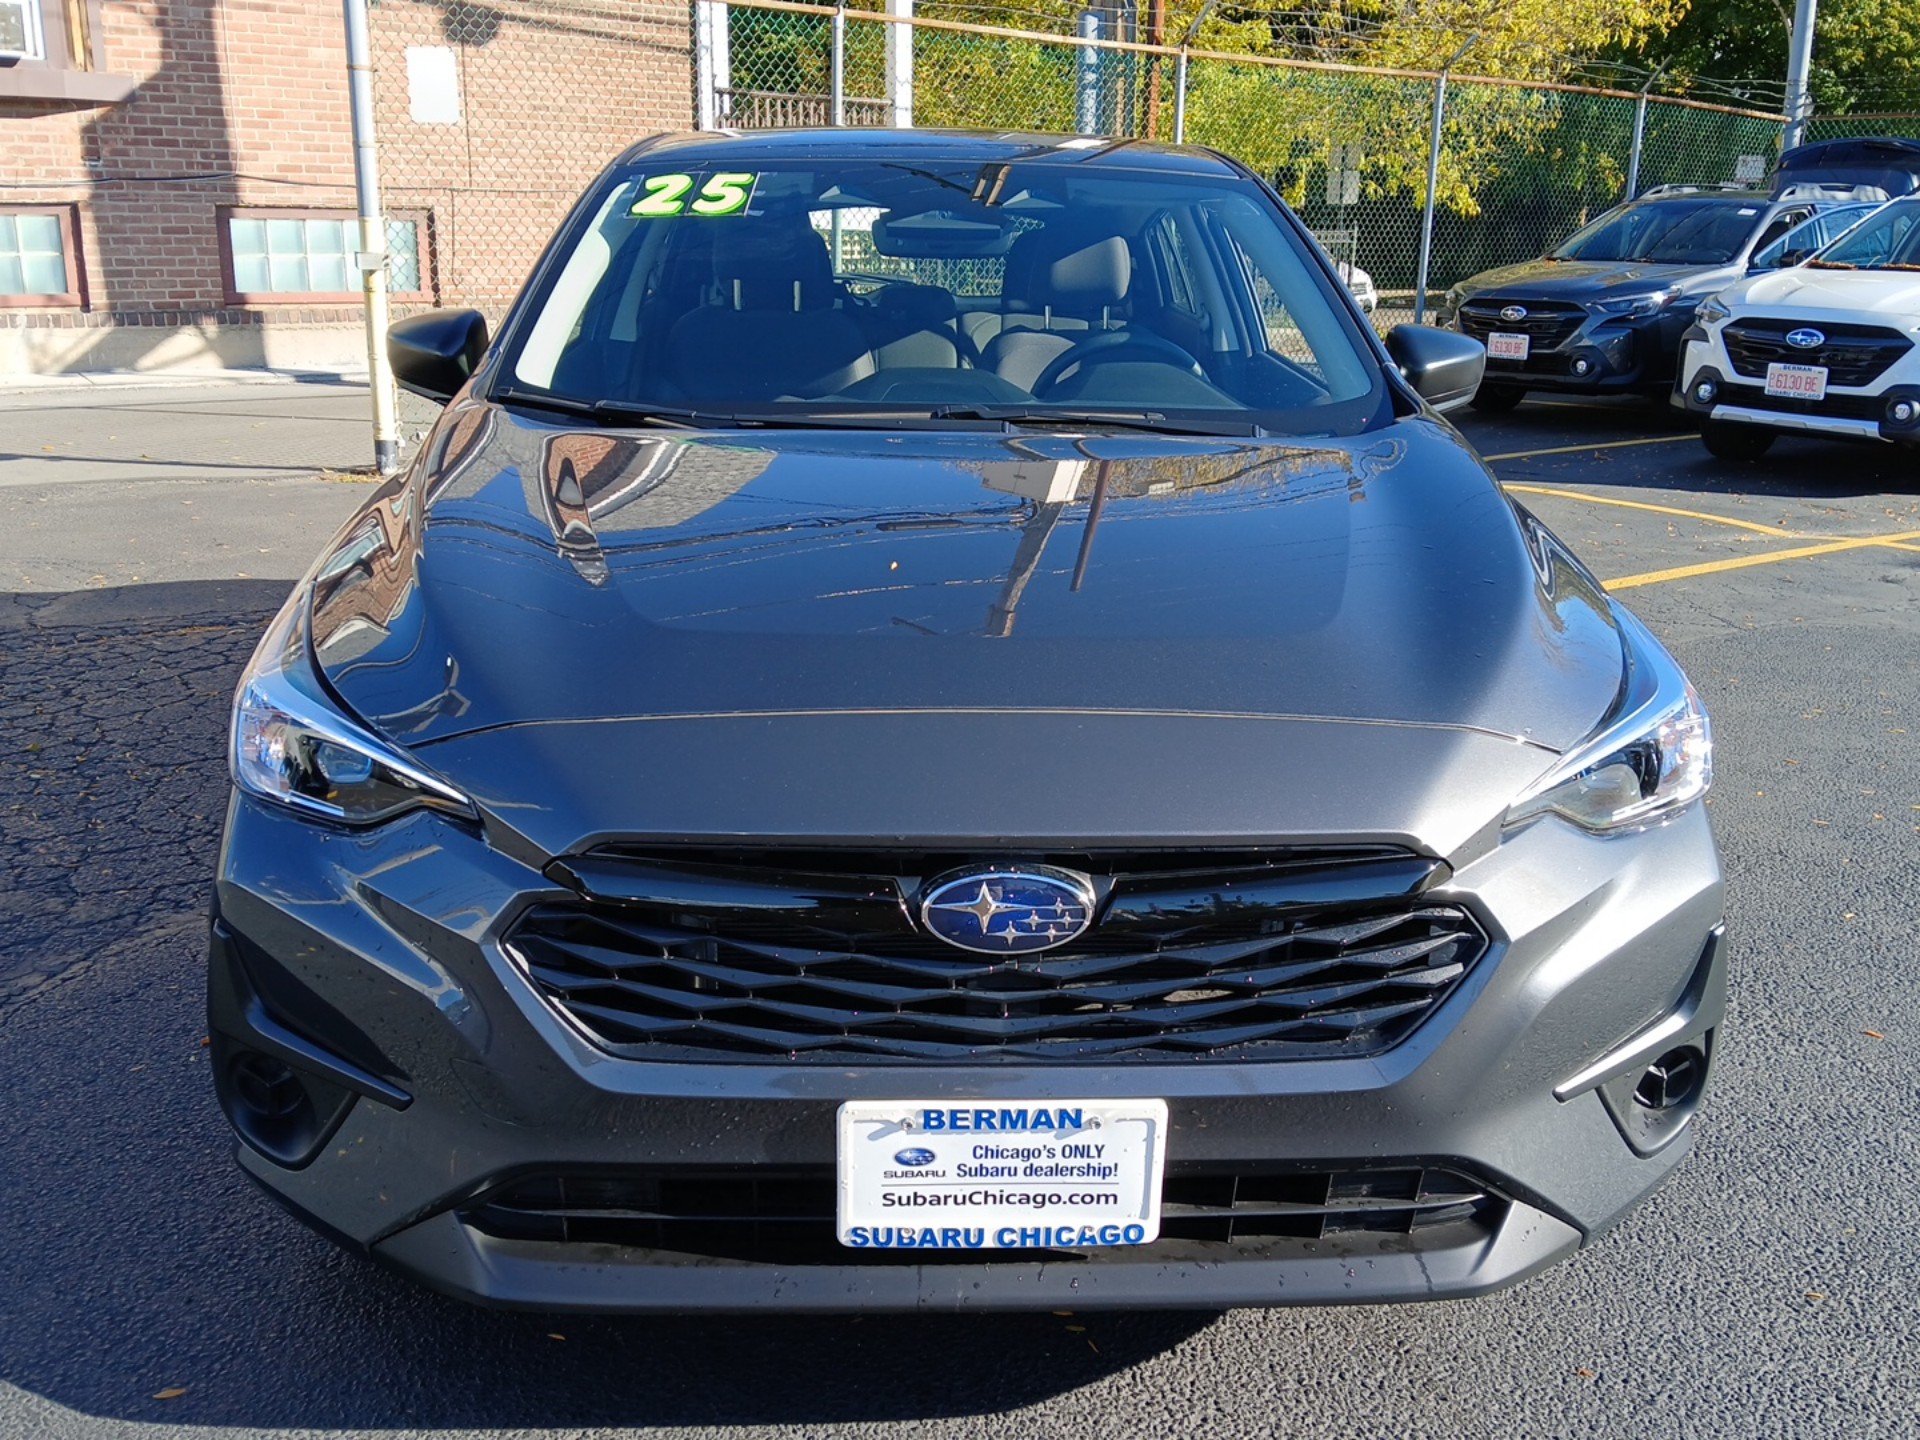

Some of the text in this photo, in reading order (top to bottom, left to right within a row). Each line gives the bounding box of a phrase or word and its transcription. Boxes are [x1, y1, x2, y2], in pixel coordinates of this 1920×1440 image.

[631, 173, 755, 215] 25
[1776, 373, 1802, 390] 6130
[1804, 376, 1819, 392] BE
[922, 1108, 1083, 1130] BERMAN
[972, 1144, 1106, 1161] Chicago's ONLY
[883, 1170, 946, 1179] SUBARU
[956, 1162, 1119, 1179] Subaru dealership!
[882, 1190, 1118, 1209] SubaruChicago.com
[850, 1223, 1146, 1248] SUBARU CHICAGO
